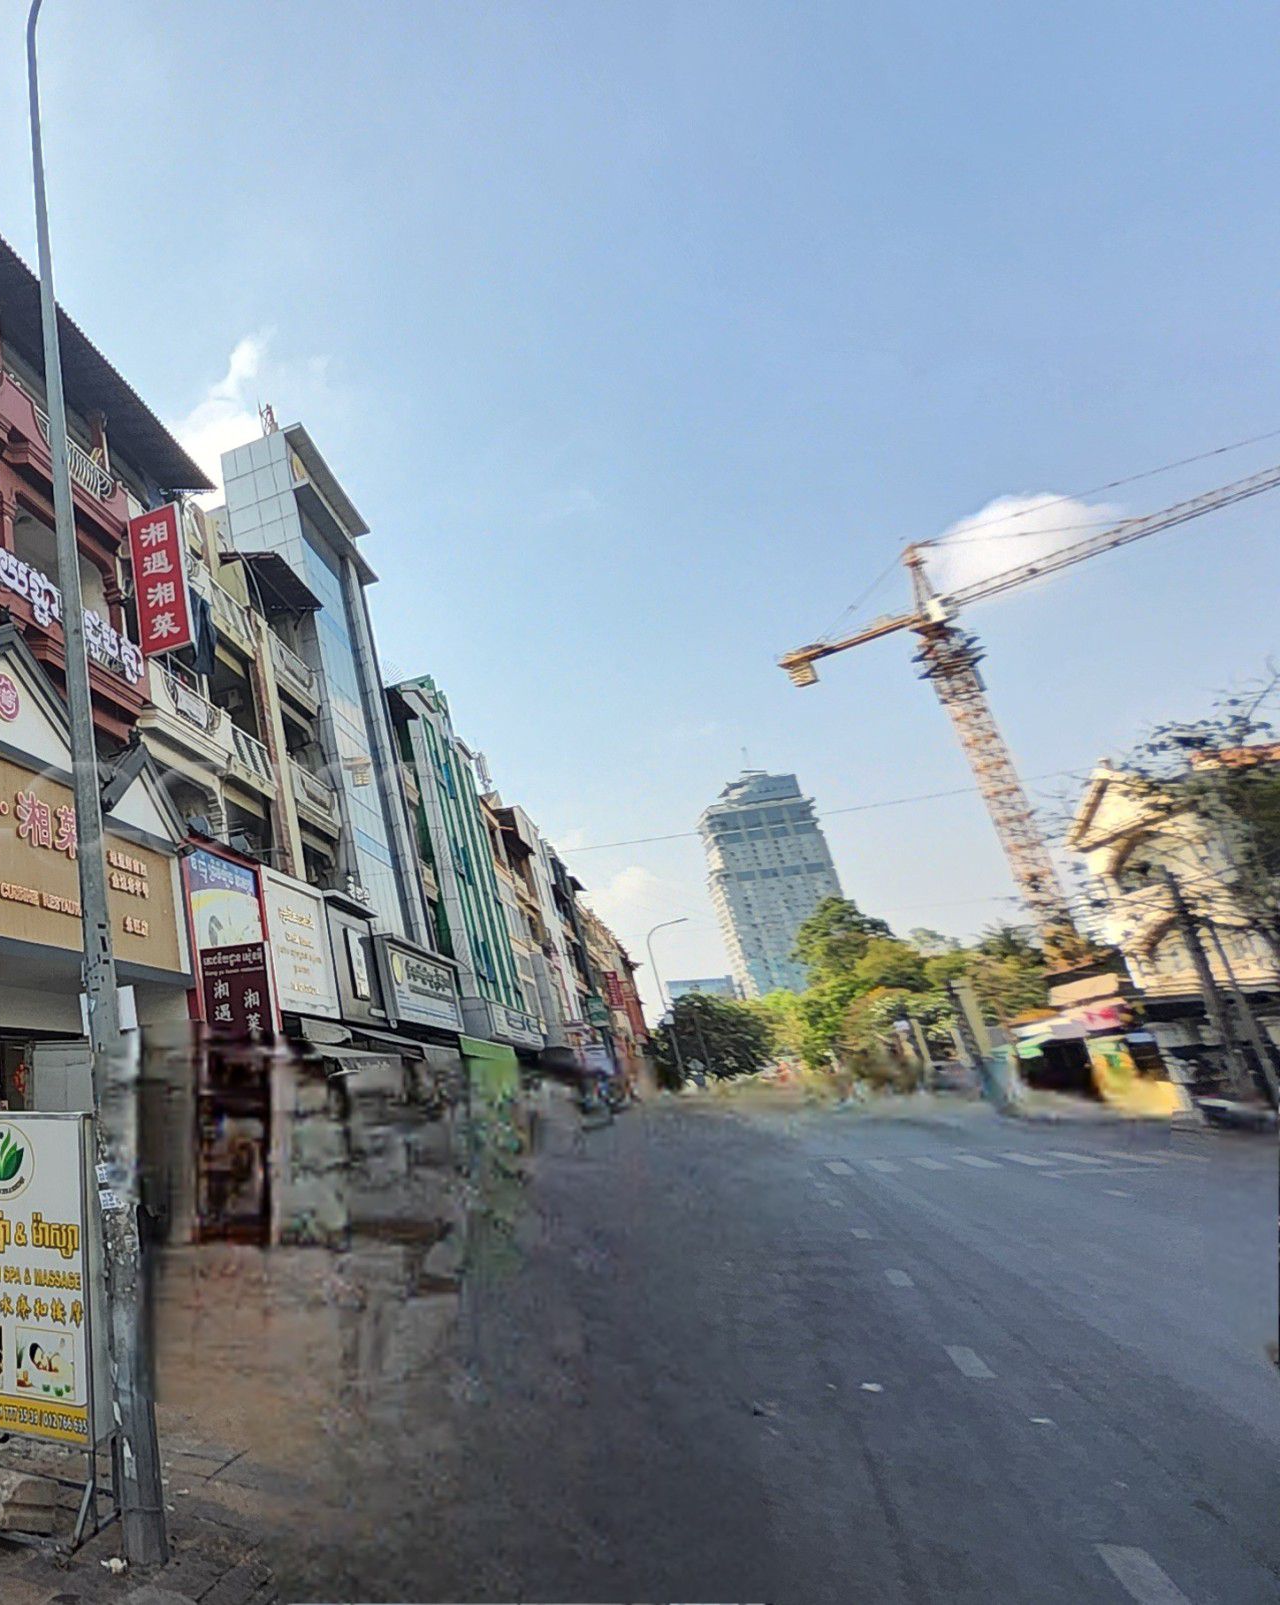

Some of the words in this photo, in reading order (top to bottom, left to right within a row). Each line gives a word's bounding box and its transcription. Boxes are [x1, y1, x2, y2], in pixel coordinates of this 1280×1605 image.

[139, 522, 180, 640] 湘遇湘菜
[0, 882, 40, 907] CUISINE
[214, 979, 234, 1021] 湘遇
[15, 1223, 26, 1246] &
[4, 1265, 21, 1285] SPA
[24, 1267, 31, 1286] &
[34, 1268, 81, 1291] MASSAGE
